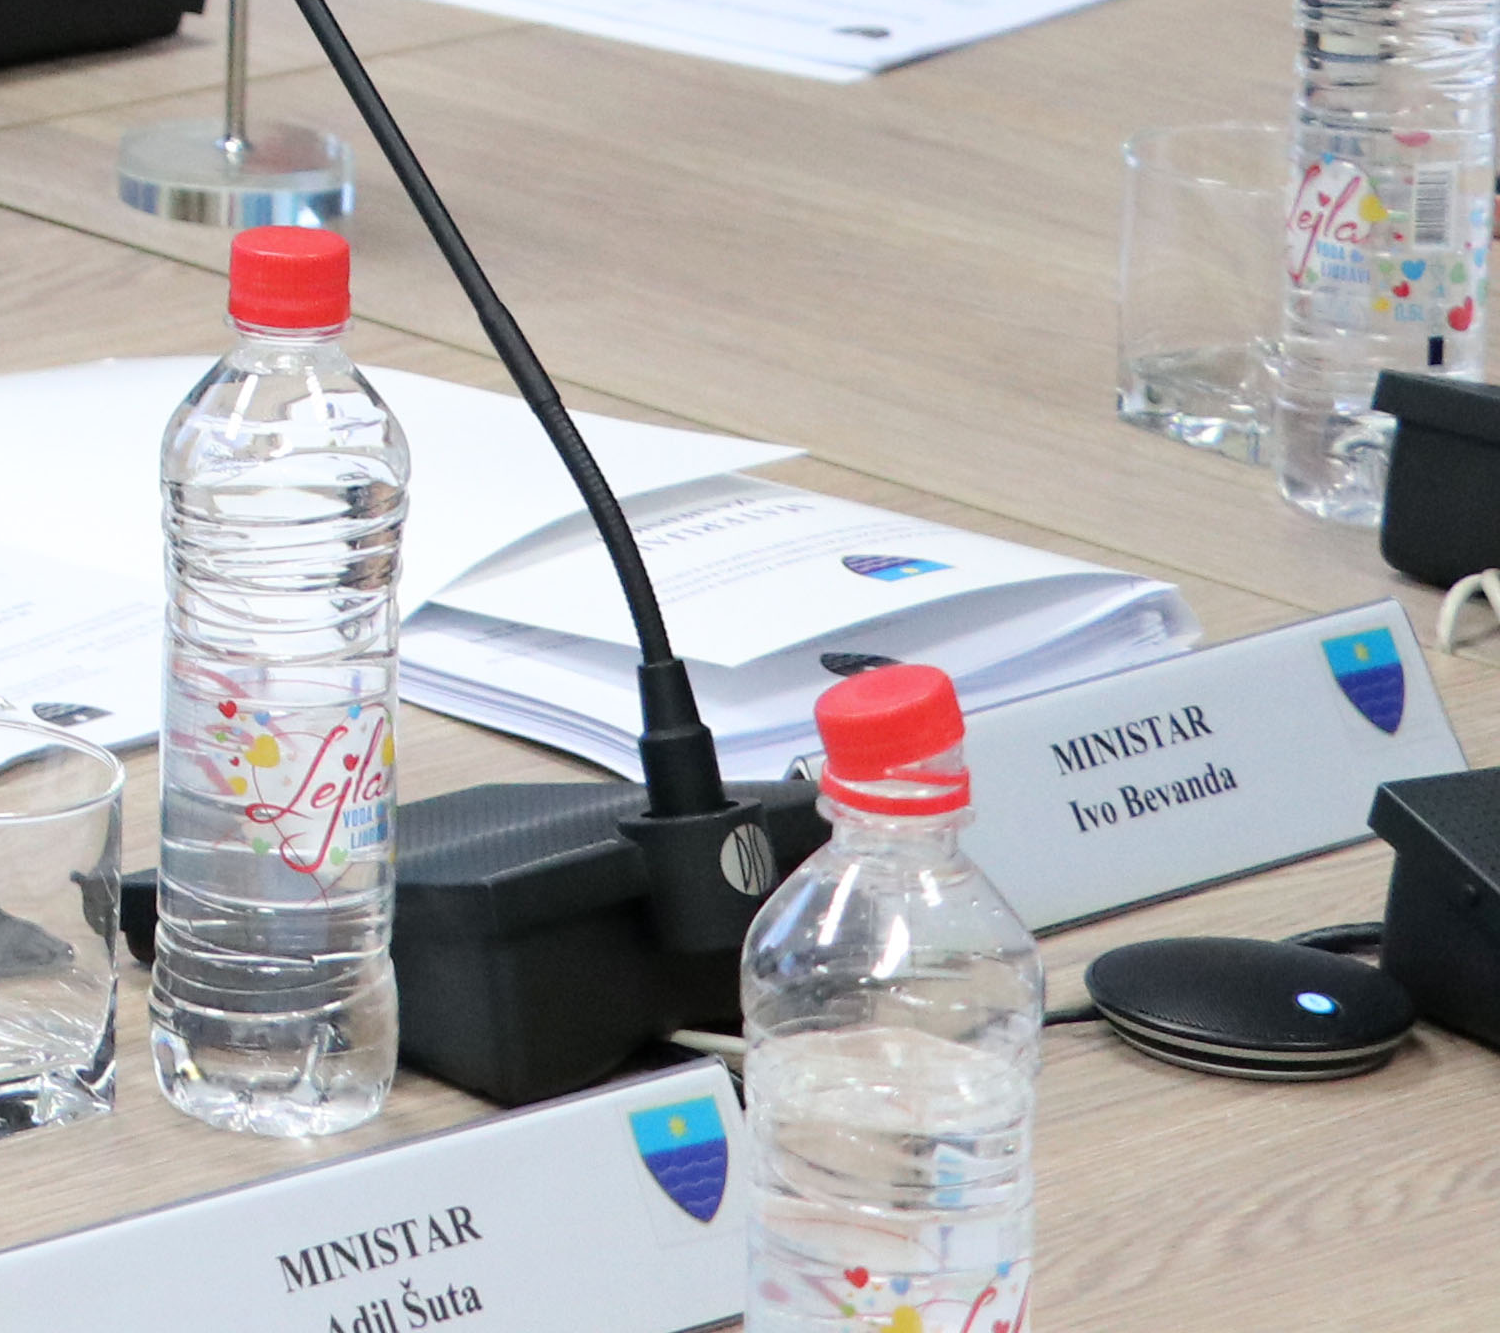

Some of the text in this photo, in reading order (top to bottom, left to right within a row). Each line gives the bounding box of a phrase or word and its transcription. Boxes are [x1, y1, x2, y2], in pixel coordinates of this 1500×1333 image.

[1049, 704, 1214, 776] MINISTAR
[245, 716, 390, 874] Lejla
[1067, 762, 1239, 833] Ivo Bevanda
[275, 1205, 483, 1294] MINISTAR
[326, 1278, 483, 1333] Adil Šuta
